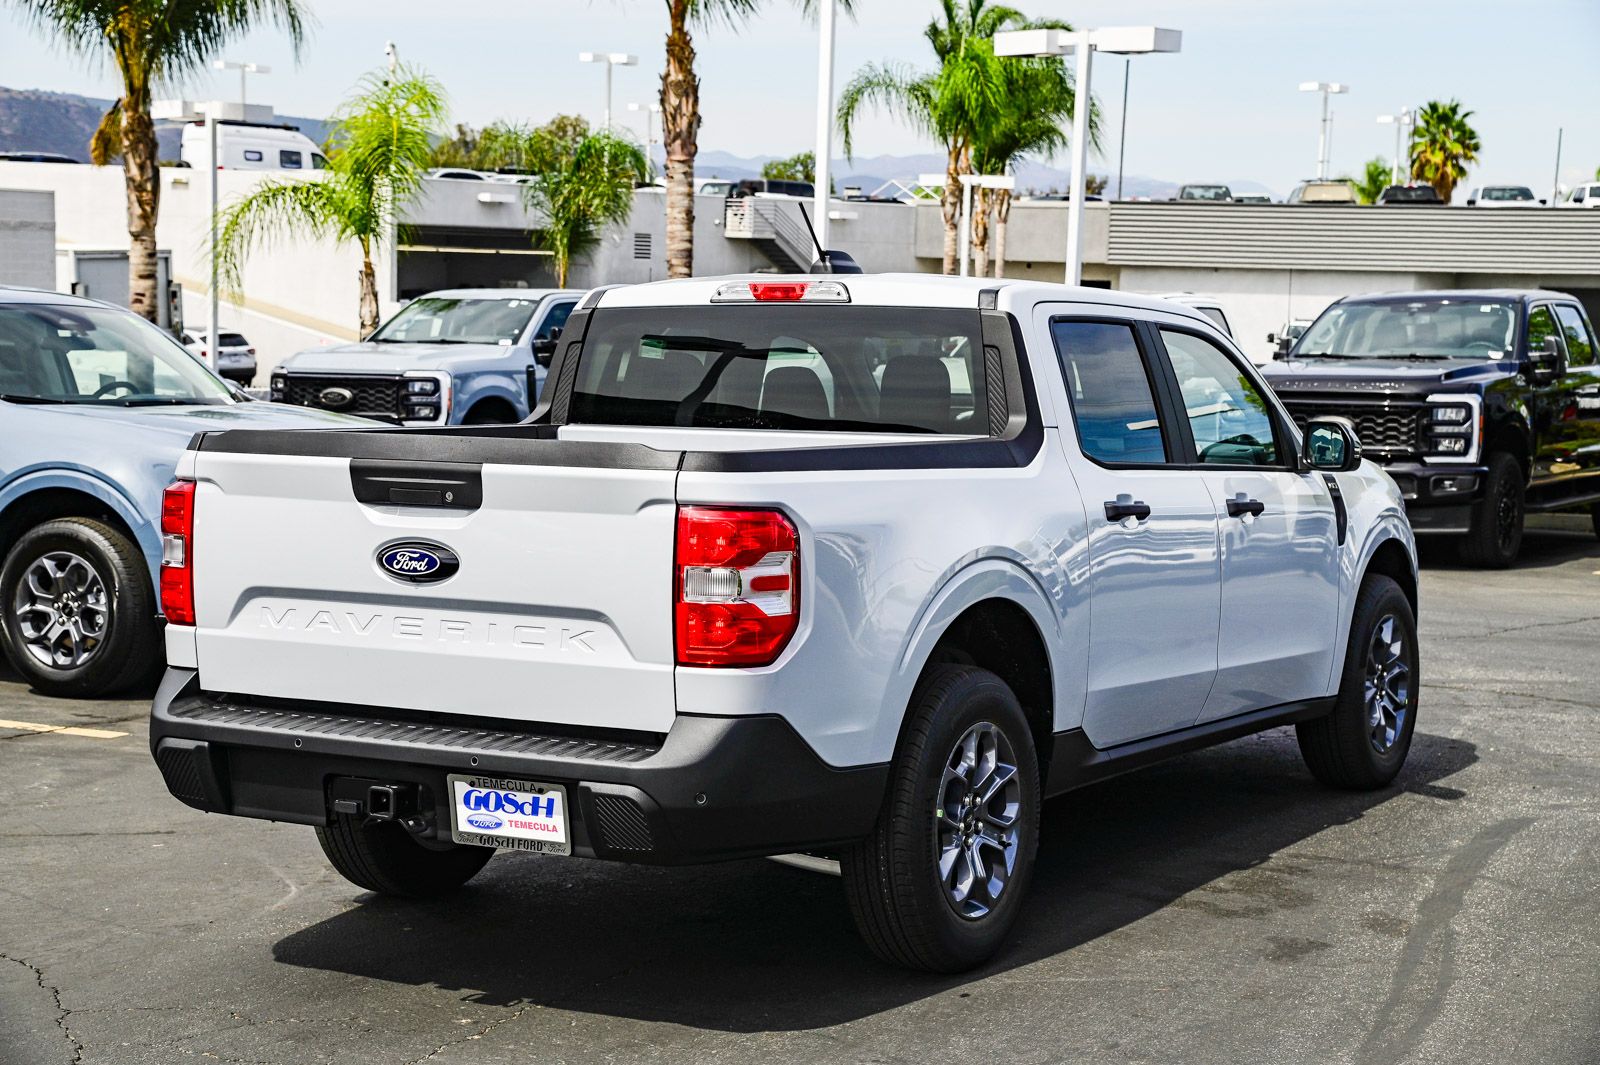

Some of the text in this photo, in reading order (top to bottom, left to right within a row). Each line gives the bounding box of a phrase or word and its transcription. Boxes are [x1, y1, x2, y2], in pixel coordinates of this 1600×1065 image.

[392, 551, 428, 571] Ford
[257, 606, 597, 653] MAVERICK
[475, 777, 538, 793] TEMECULA
[507, 819, 559, 833] TEMECULA
[517, 839, 543, 852] FORD
